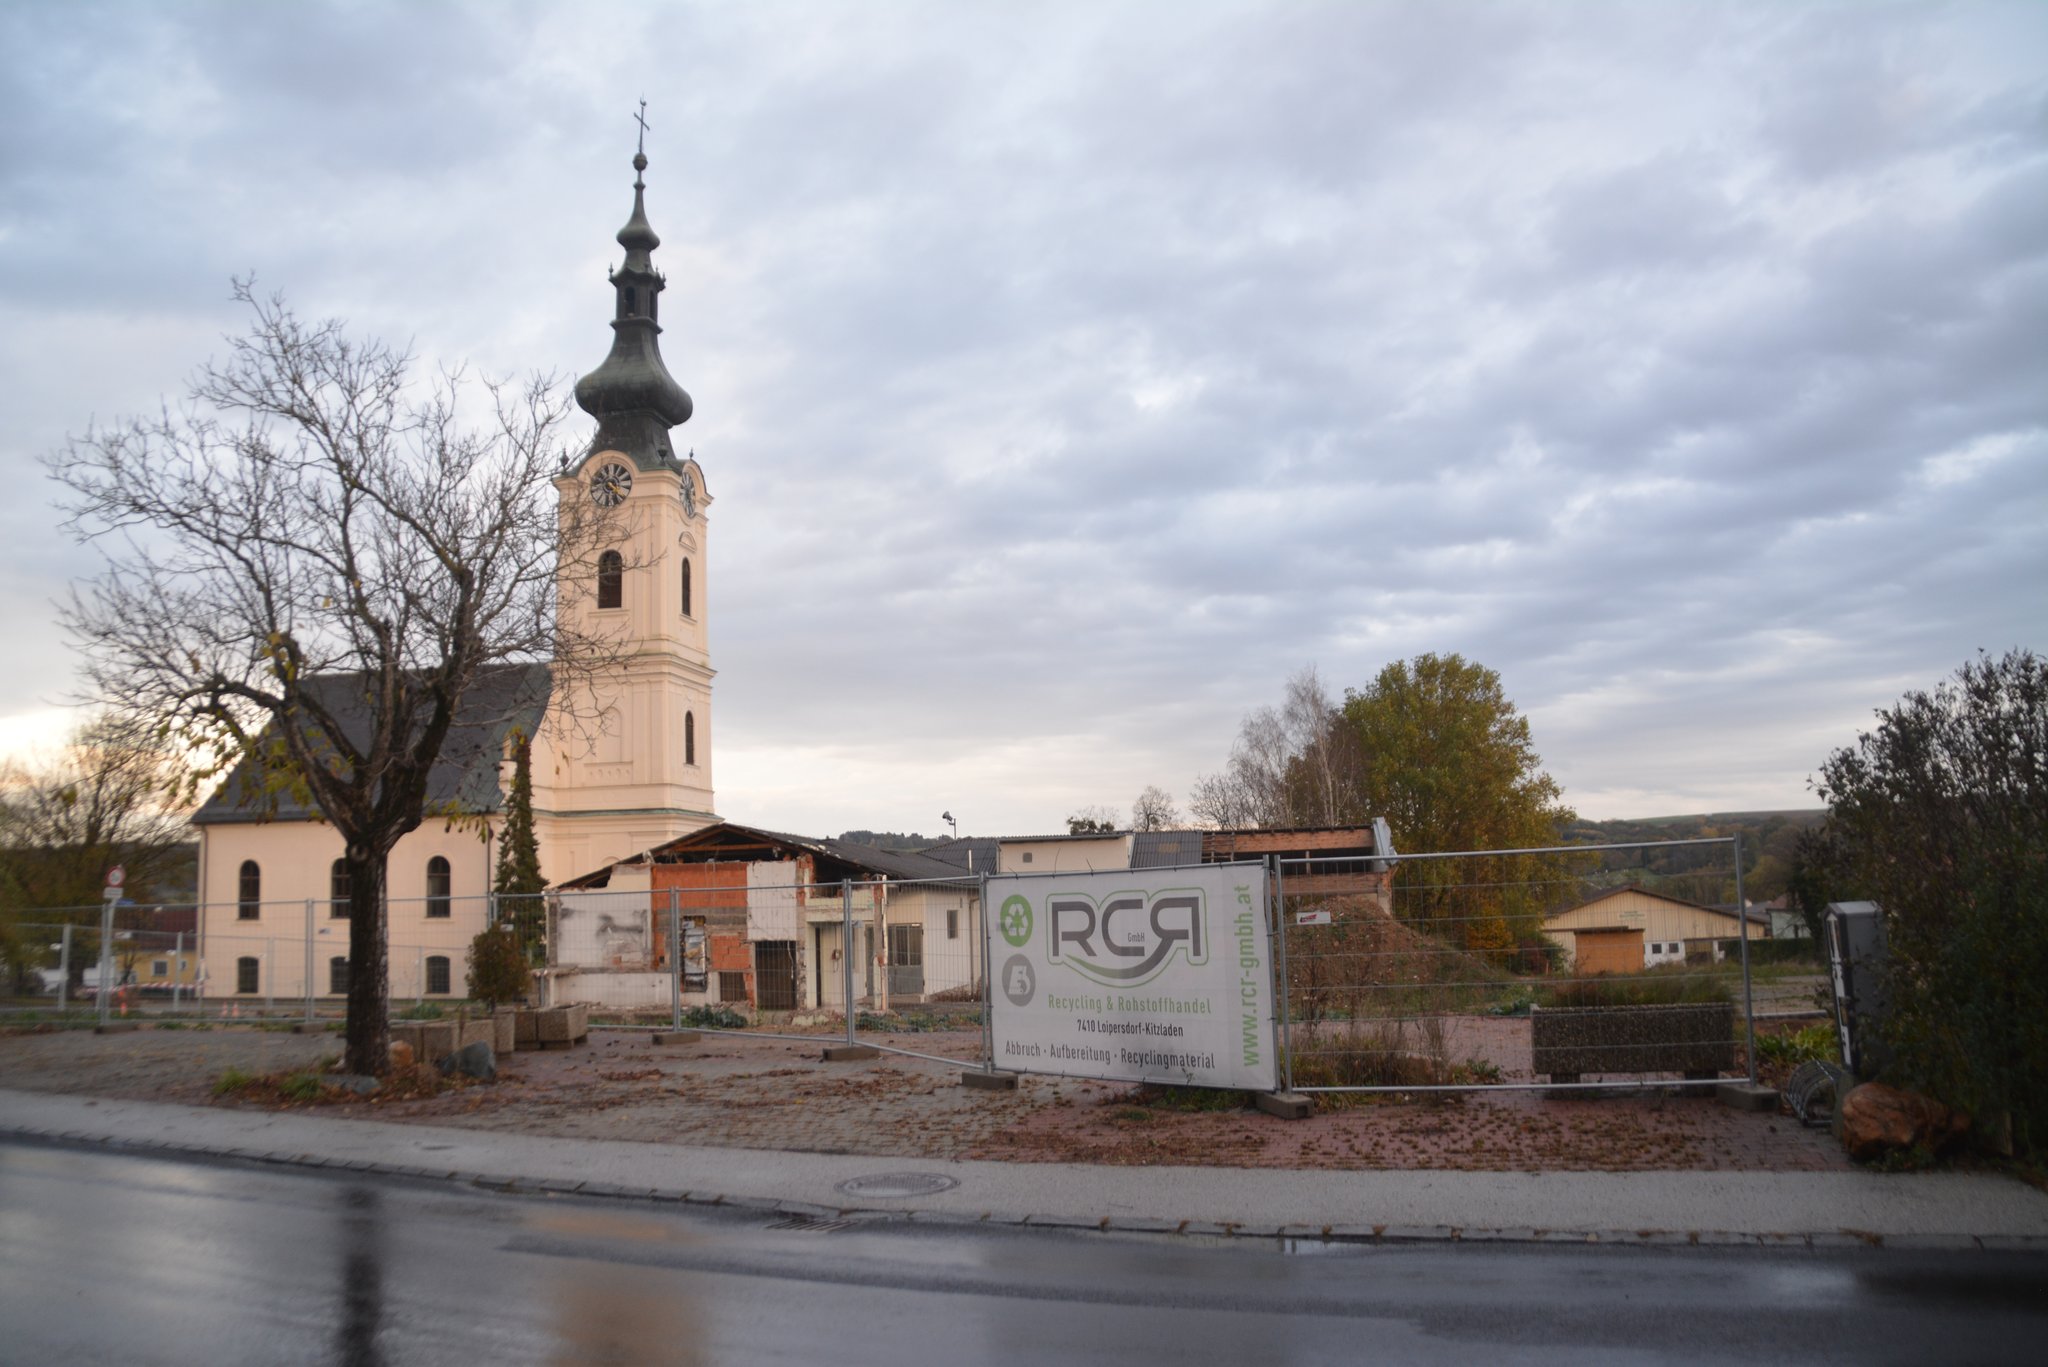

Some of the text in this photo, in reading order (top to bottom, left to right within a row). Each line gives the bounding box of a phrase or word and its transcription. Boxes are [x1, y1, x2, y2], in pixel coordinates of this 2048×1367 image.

[1127, 932, 1145, 943] GmbH
[1233, 884, 1260, 1066] www.rcr-gmbh.at
[1048, 994, 1212, 1014] Recycling & Rohstoffhandel
[1077, 1019, 1184, 1037] 7410 Loipersdorf-Kitzladen
[1005, 1040, 1216, 1070] Abbruch Aufbereitung Recyclingmaterial
